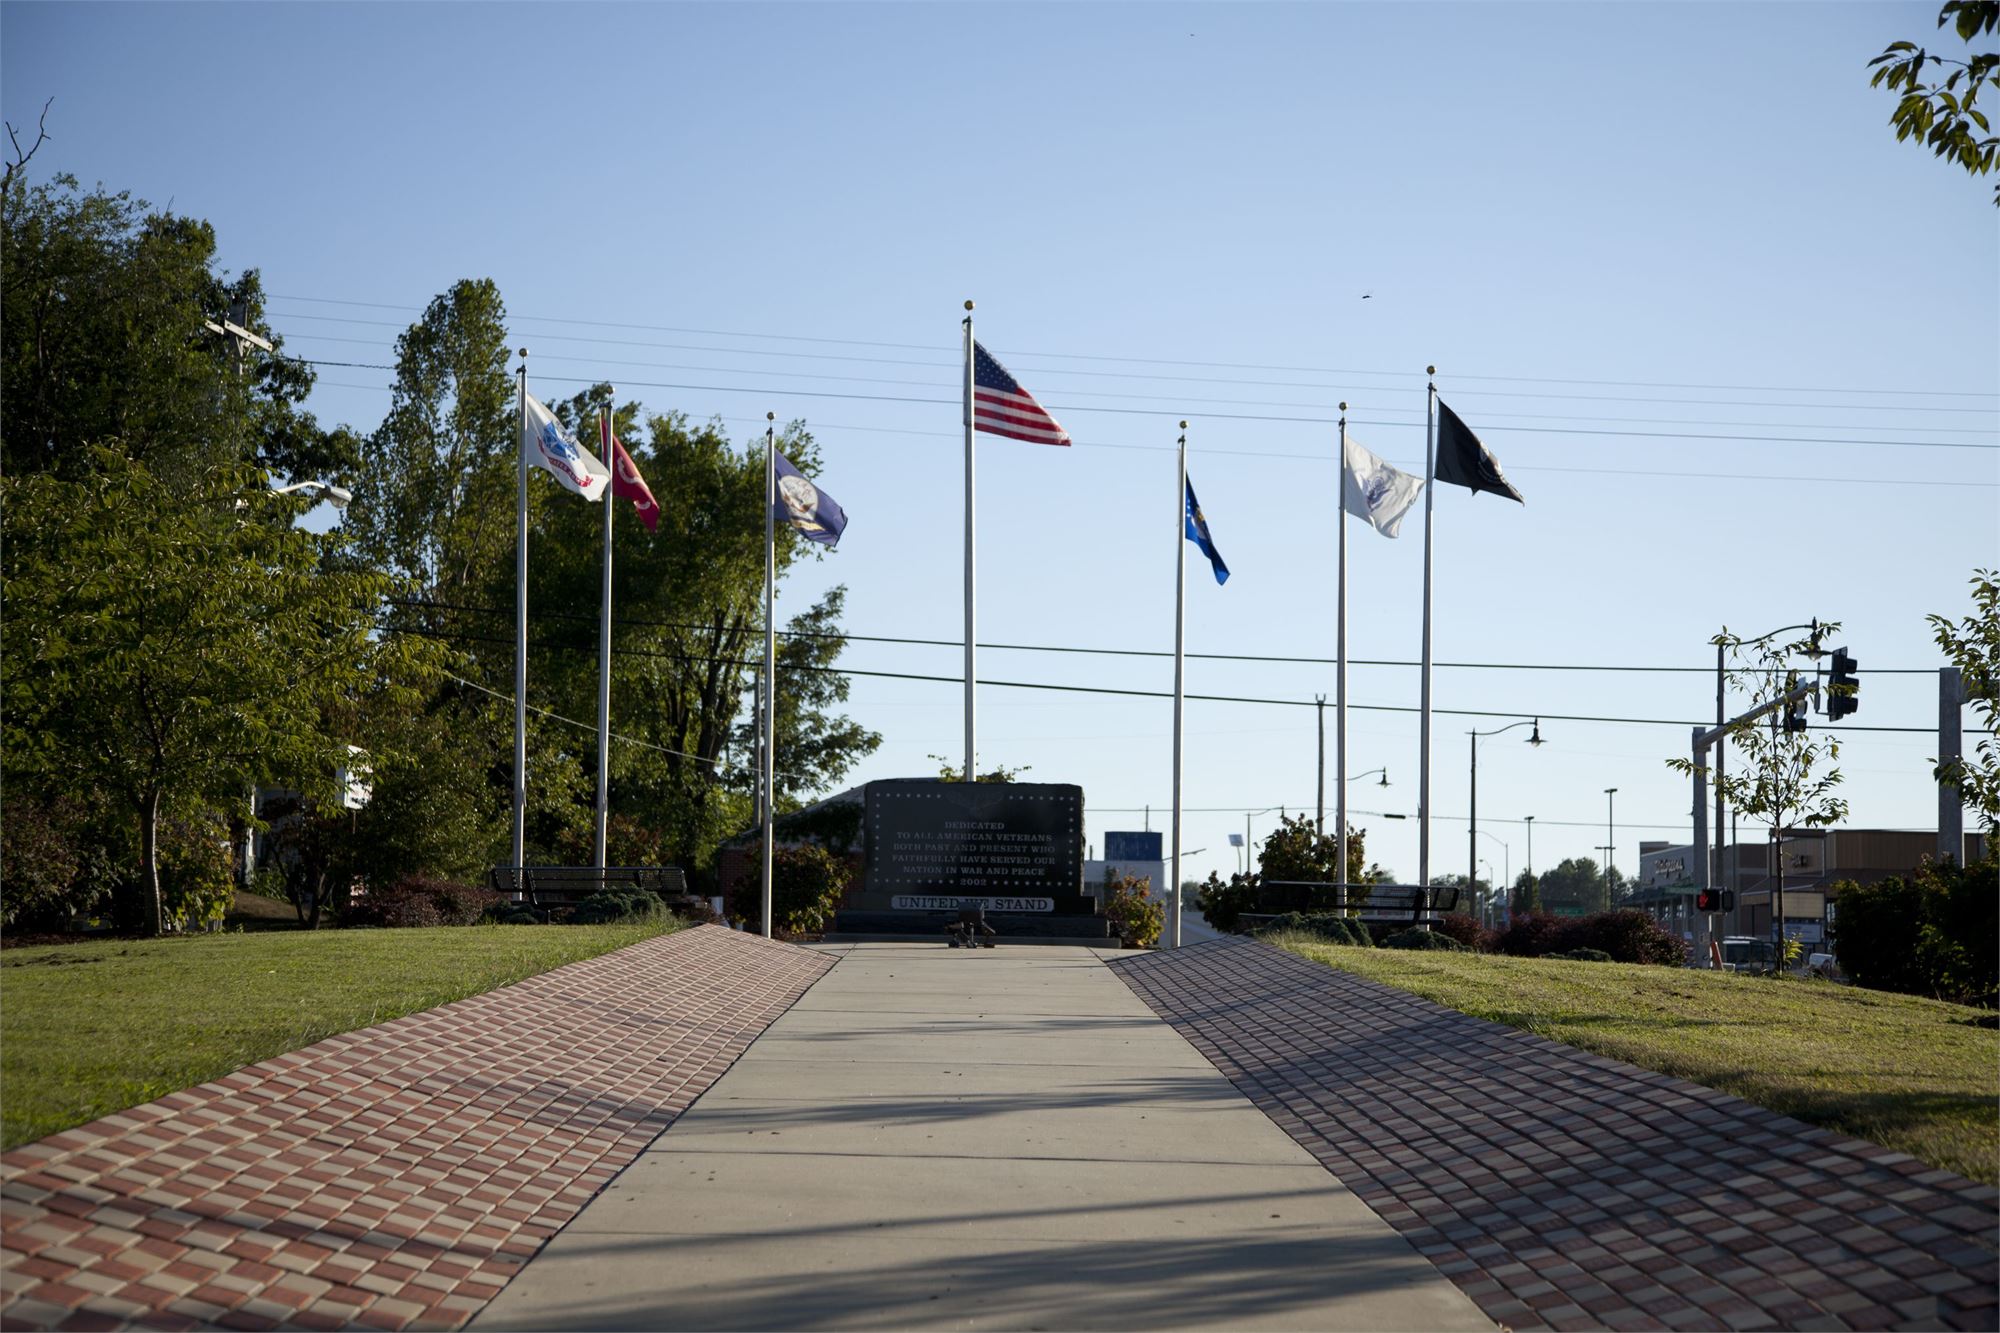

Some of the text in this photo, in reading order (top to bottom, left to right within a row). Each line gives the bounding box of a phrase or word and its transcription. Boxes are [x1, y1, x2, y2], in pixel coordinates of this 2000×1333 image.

[944, 821, 1005, 830] DEDICATED
[896, 831, 1053, 842] TO ALL AMERICAN VETERANS
[893, 843, 1056, 854] BOTH PAST AND PRESENT WHO
[892, 854, 1056, 865] FAITHFULLY HAVE SERVED OUR
[903, 865, 1046, 876] NATION IN WAR AND PEACE
[960, 878, 987, 886] 2002
[899, 896, 960, 909] UNITED
[995, 899, 1048, 910] STAND
